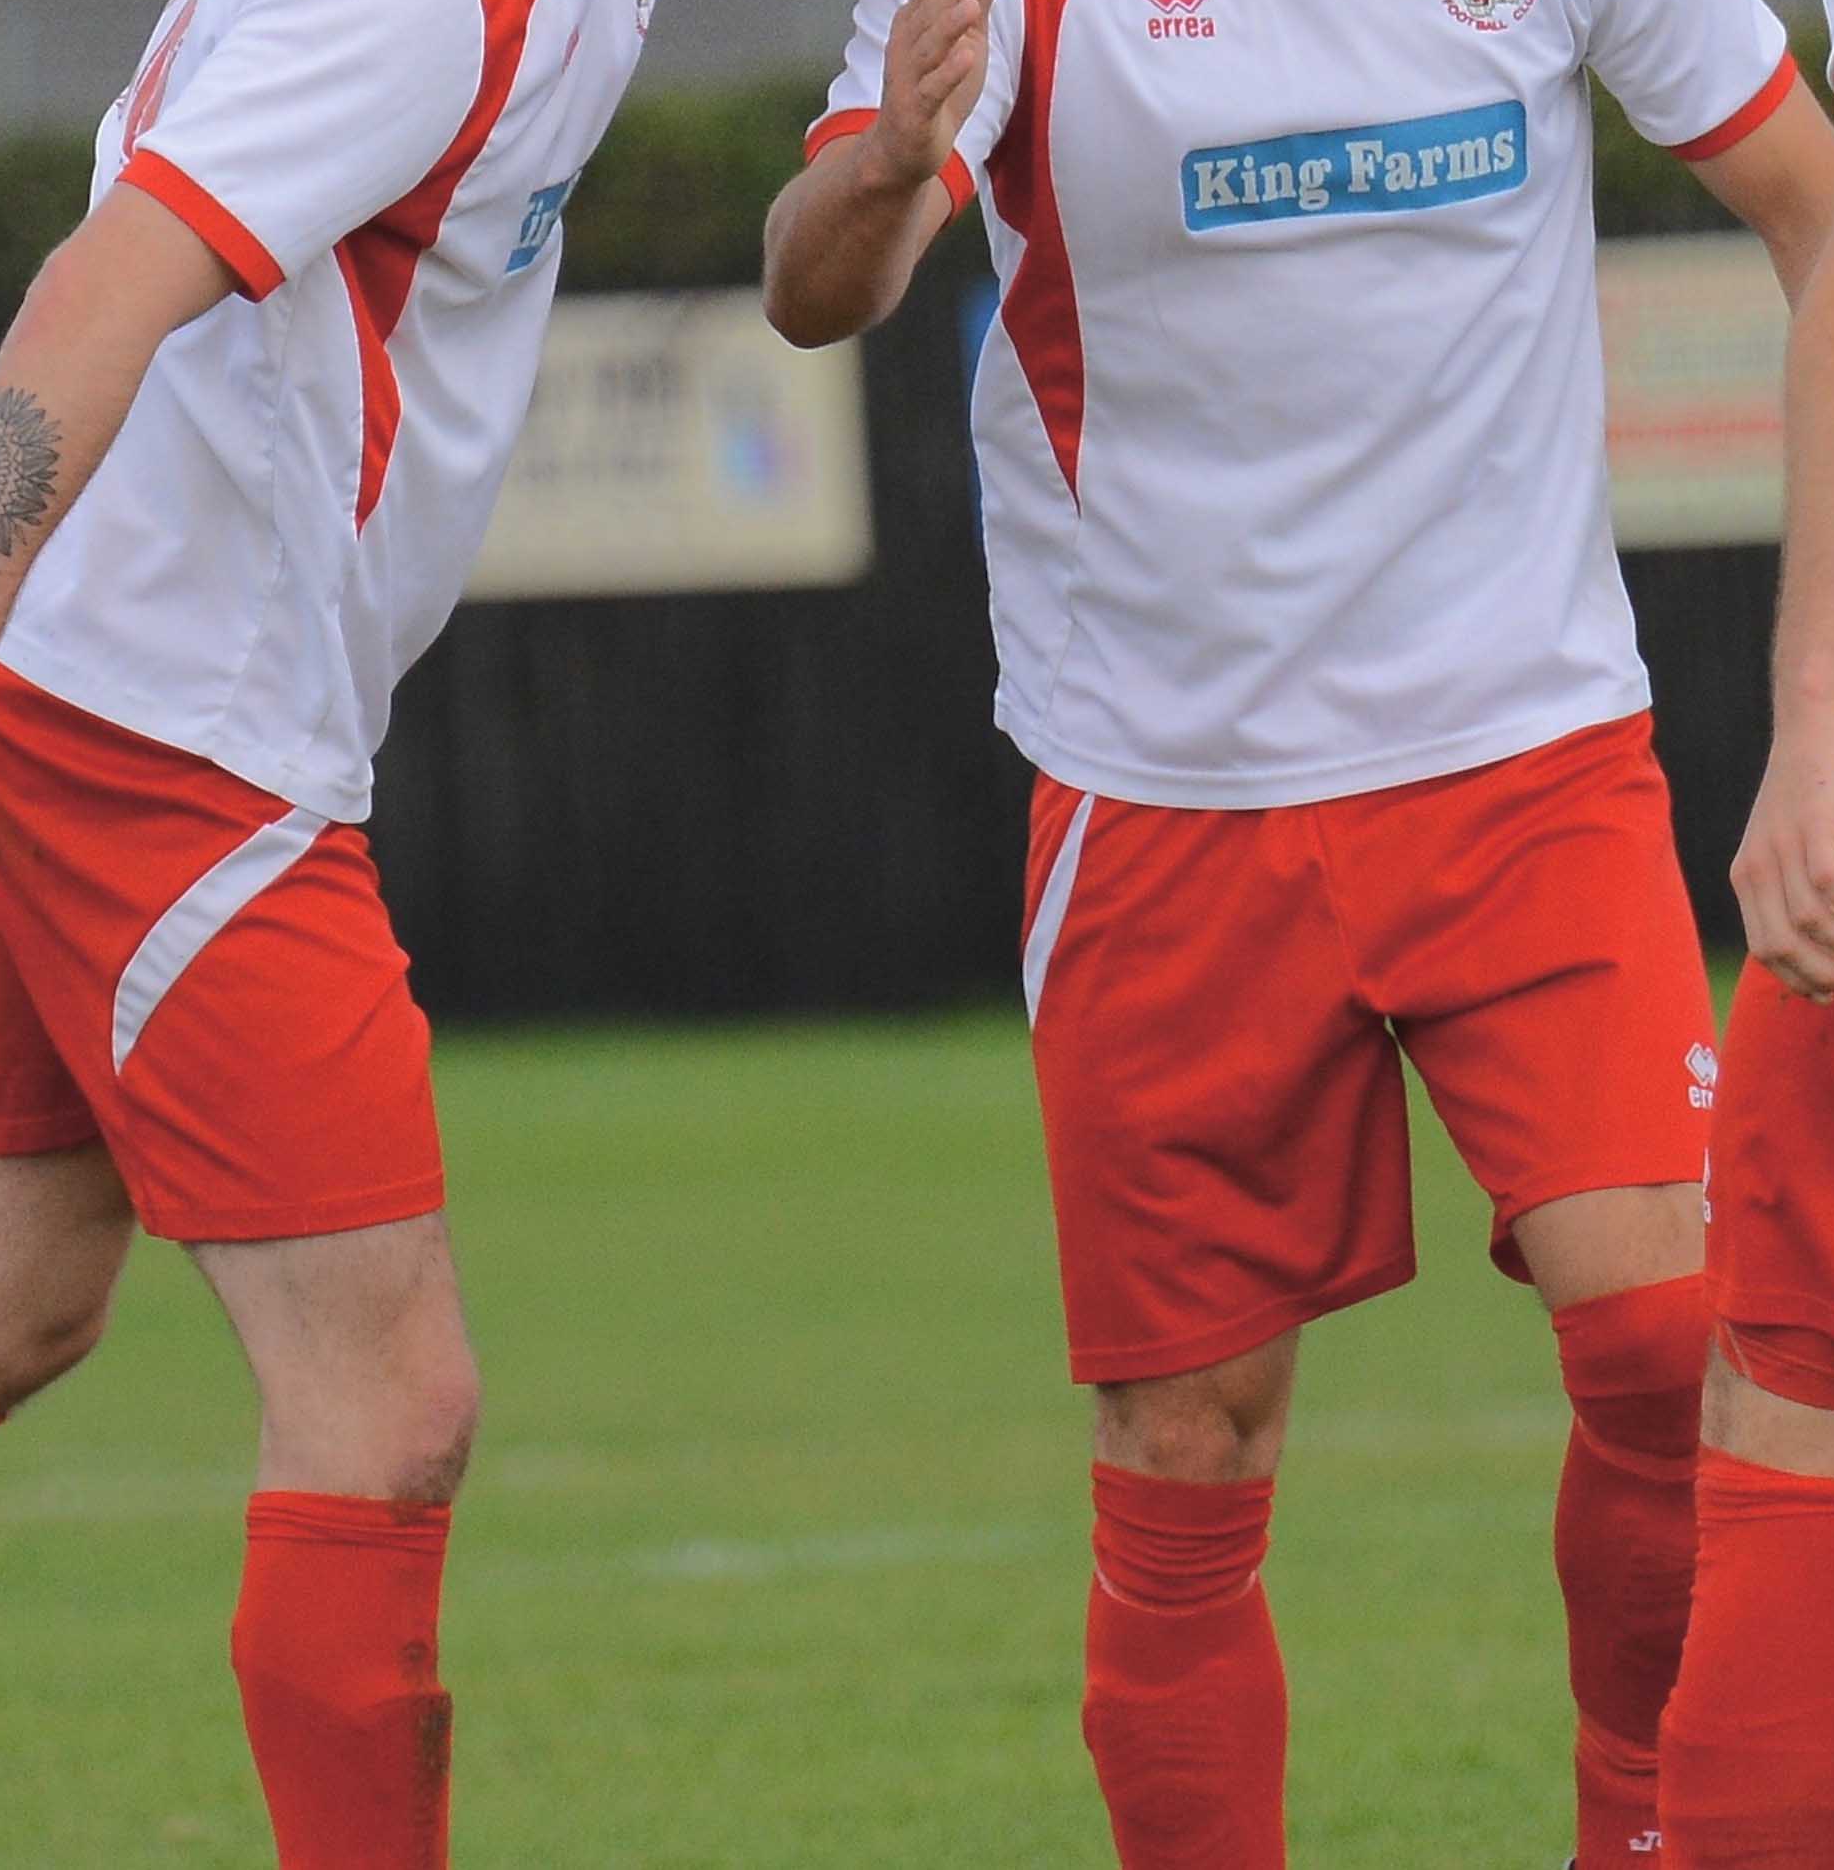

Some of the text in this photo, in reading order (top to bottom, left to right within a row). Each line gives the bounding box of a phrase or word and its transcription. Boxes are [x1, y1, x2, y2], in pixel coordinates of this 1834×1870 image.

[1147, 16, 1215, 39] errea
[1193, 128, 1516, 211] King Farms
